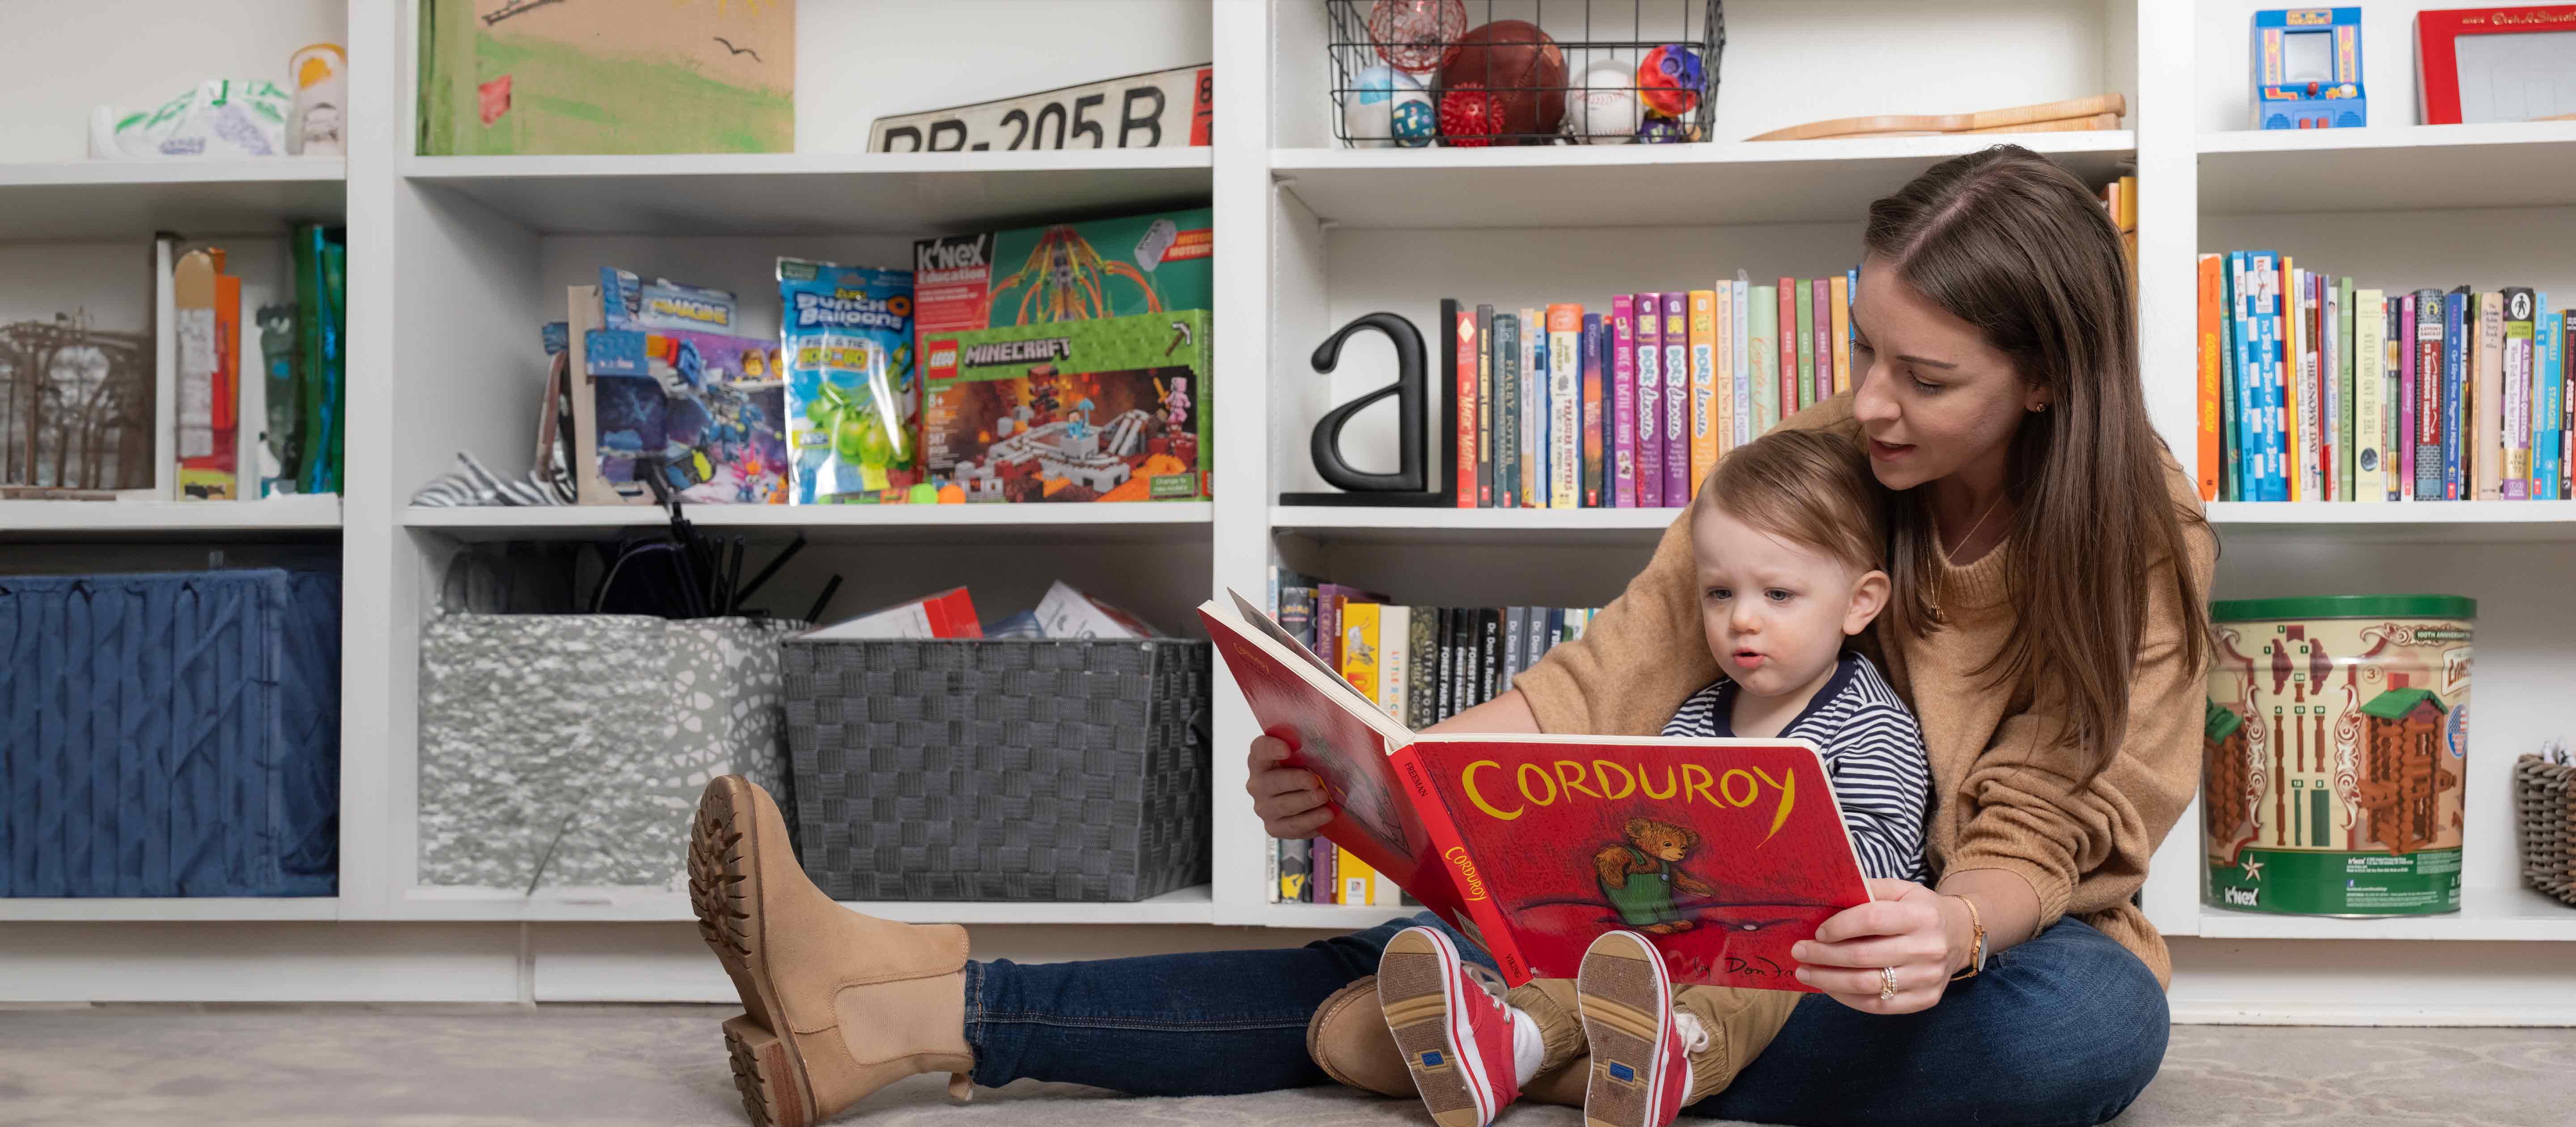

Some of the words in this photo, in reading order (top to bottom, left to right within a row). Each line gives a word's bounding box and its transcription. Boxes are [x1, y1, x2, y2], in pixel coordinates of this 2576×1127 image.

[931, 350, 957, 369] LEGO
[965, 336, 1071, 367] MINECRAFT
[2204, 332, 2216, 395] GOODNIGHT
[1505, 359, 1515, 409] HARRY
[2307, 360, 2318, 380] THE
[2204, 399, 2217, 434] MOON
[2262, 333, 2272, 351] BIG
[2267, 446, 2277, 473] Books
[2308, 382, 2318, 429] SNOWY
[2342, 366, 2351, 453] MILLIONAIRE
[2547, 386, 2557, 432] STARGIRL
[1505, 415, 1515, 465] POTTER
[2520, 402, 2529, 443] QUESTIONS
[2309, 432, 2319, 454] DAY
[1487, 623, 1496, 635] Dr.
[1507, 634, 1517, 653] Don
[1509, 621, 1518, 633] Dr.
[1530, 635, 1541, 653] Don
[1532, 621, 1542, 633] Dr.
[1423, 640, 1434, 682] LITTLE
[1486, 637, 1496, 655] Don
[1391, 650, 1400, 683] LITTLE
[1441, 646, 1450, 682] FOREST
[1467, 646, 1478, 682] FOREST
[2367, 668, 2376, 679] 3
[1439, 682, 1449, 706] PARK
[1466, 682, 1476, 706] PARK
[1483, 667, 1495, 702] Roberts
[1422, 688, 1433, 725] ROCK
[1405, 761, 1428, 798] FREEMAN
[1462, 759, 1795, 849] CORDUROY
[1445, 846, 1488, 901] CORDUROY
[1505, 953, 1522, 979] VIKING
[1724, 957, 1767, 976] Don
